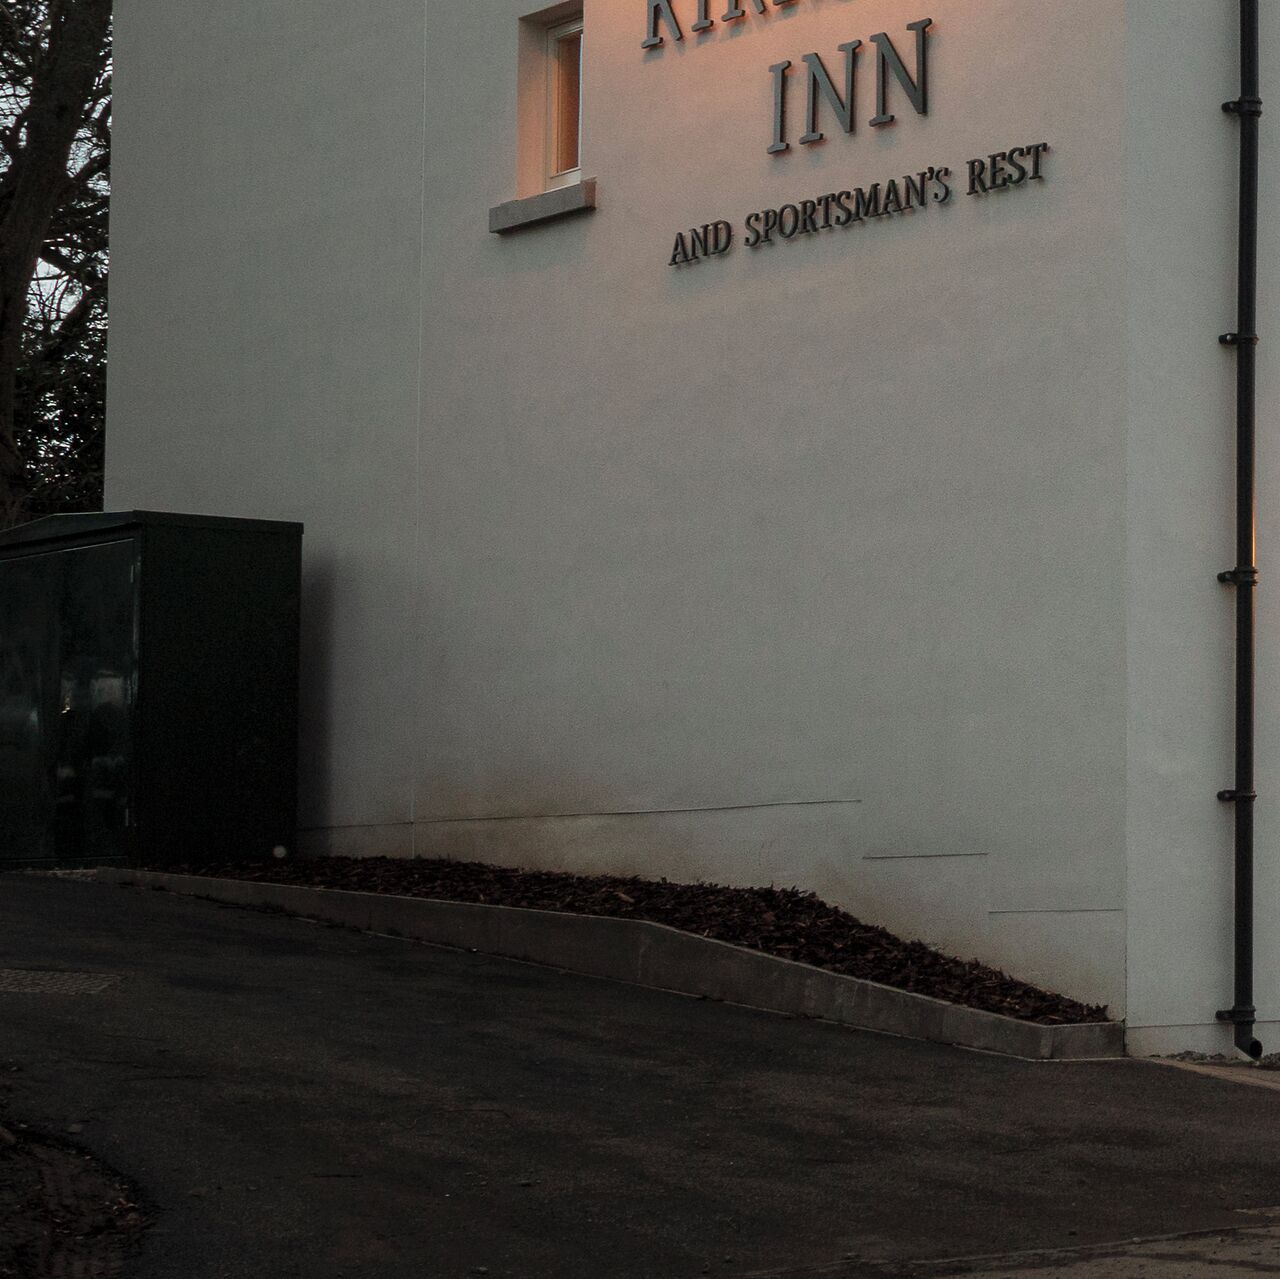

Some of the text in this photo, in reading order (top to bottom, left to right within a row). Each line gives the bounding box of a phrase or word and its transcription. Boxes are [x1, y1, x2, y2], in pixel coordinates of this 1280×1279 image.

[767, 17, 933, 155] INN
[668, 142, 1049, 266] AND SPORTSMAN'S REST
